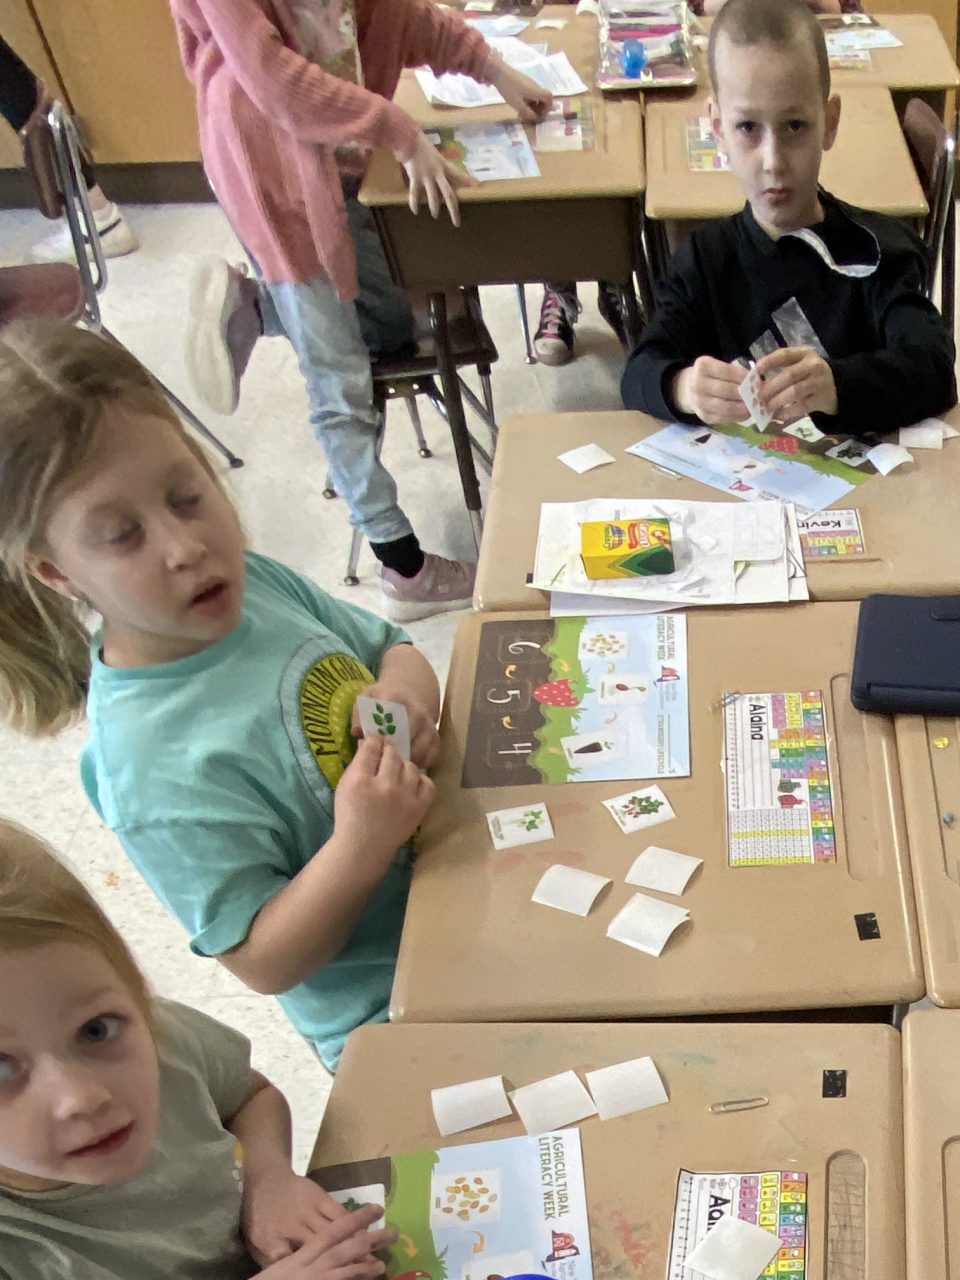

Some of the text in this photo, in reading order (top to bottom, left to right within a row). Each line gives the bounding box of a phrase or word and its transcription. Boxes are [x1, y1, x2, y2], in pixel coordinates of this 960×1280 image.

[796, 517, 841, 529] Kevin
[508, 640, 541, 655] 6
[301, 663, 342, 756] MOUNTAIN
[487, 688, 521, 704] 5
[749, 703, 765, 741] Alaina
[497, 741, 532, 755] 4
[538, 1137, 557, 1221] LITERACY WEEK
[552, 1136, 570, 1217] AGRICULTURAL
